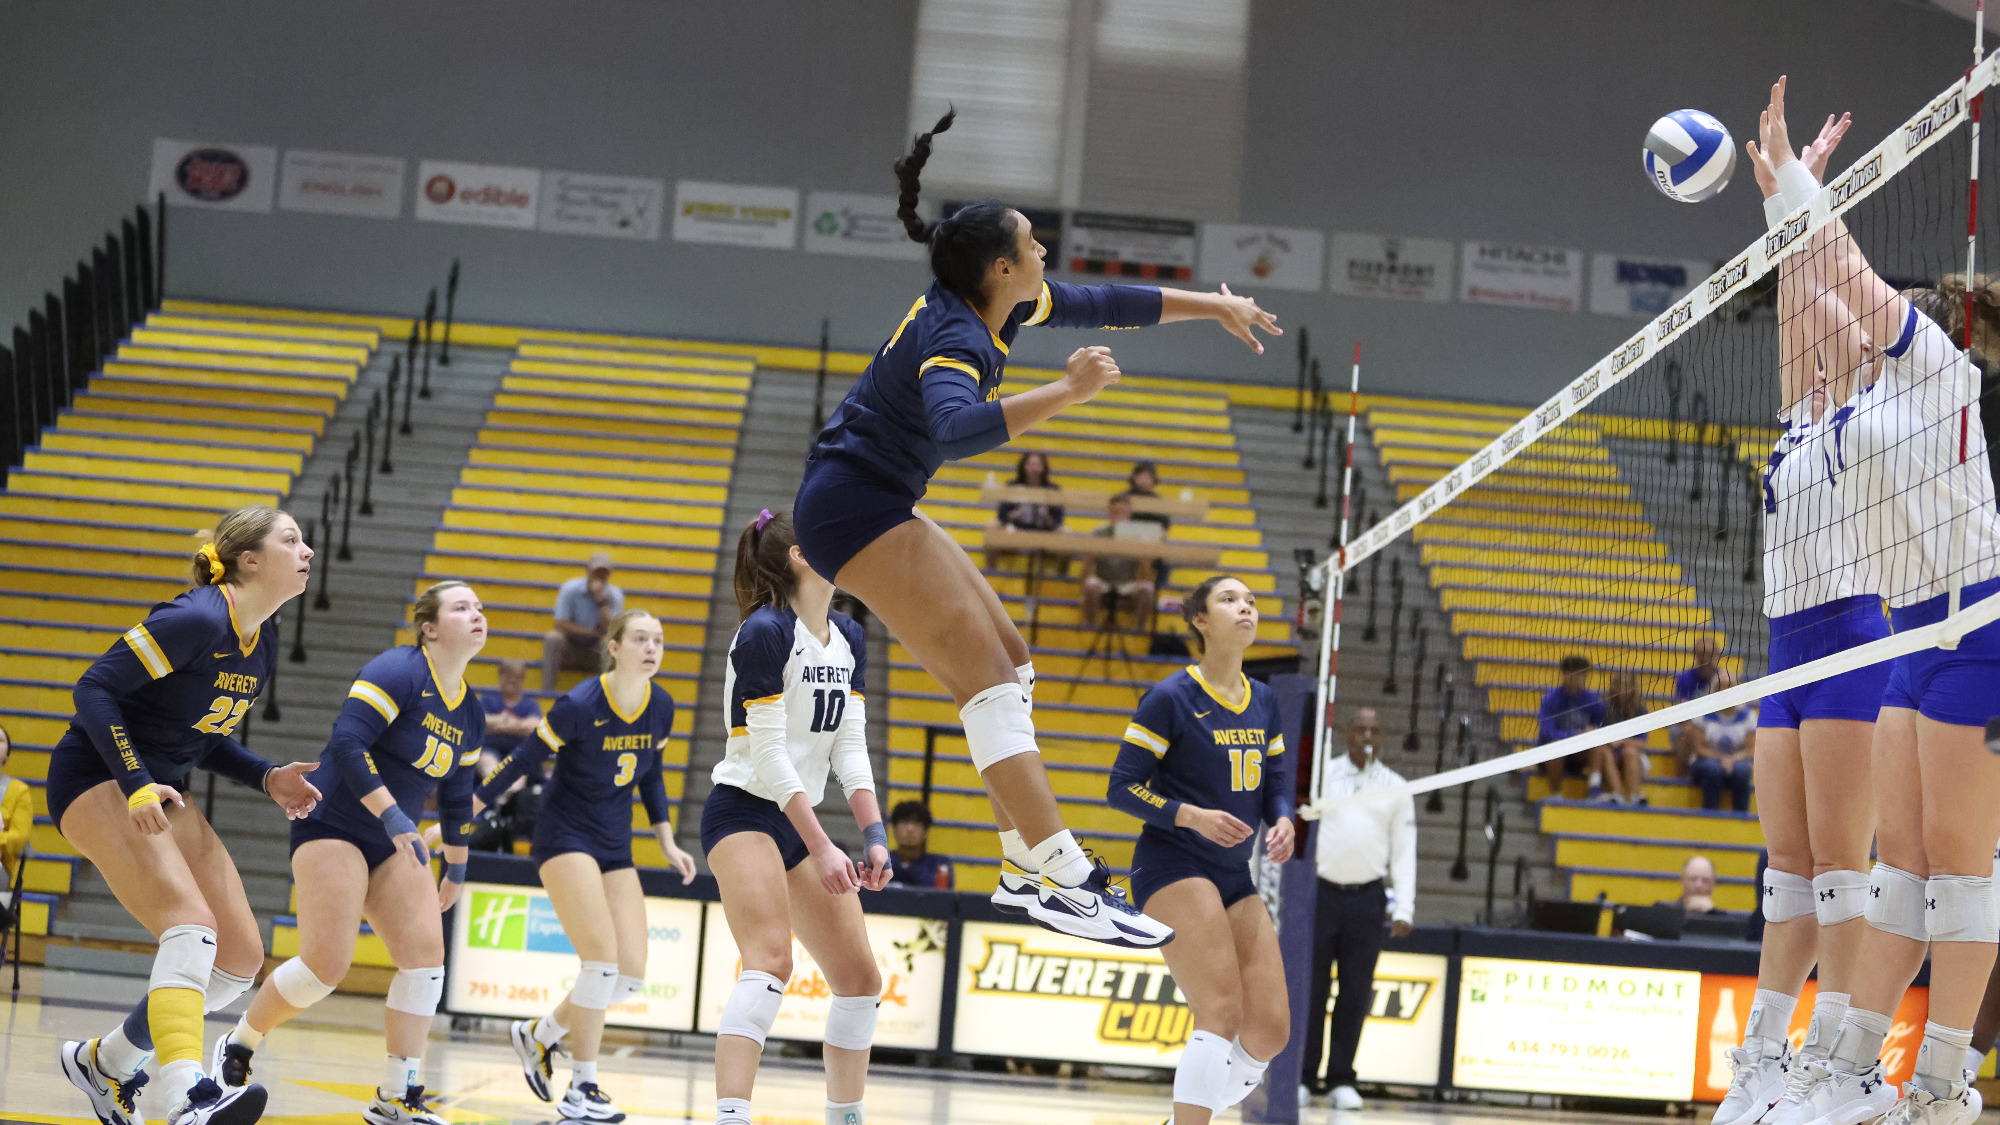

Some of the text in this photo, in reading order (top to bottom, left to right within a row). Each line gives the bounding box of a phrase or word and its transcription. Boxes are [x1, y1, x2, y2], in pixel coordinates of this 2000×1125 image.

[213, 671, 258, 694] AVERETT
[802, 665, 851, 685] AVERETT
[191, 695, 259, 737] 22
[810, 688, 846, 733] 10
[421, 711, 464, 746] AVERETT
[602, 734, 652, 752] AVERETT
[1212, 728, 1265, 746] AVERETT
[110, 724, 141, 772] AVERETT
[411, 735, 453, 778] 19
[614, 752, 637, 787] 3
[1228, 748, 1262, 792] 16
[977, 943, 1170, 1002] AVERETT
[1505, 972, 1685, 998] PIEDMONT
[469, 980, 549, 1002] 791-2661
